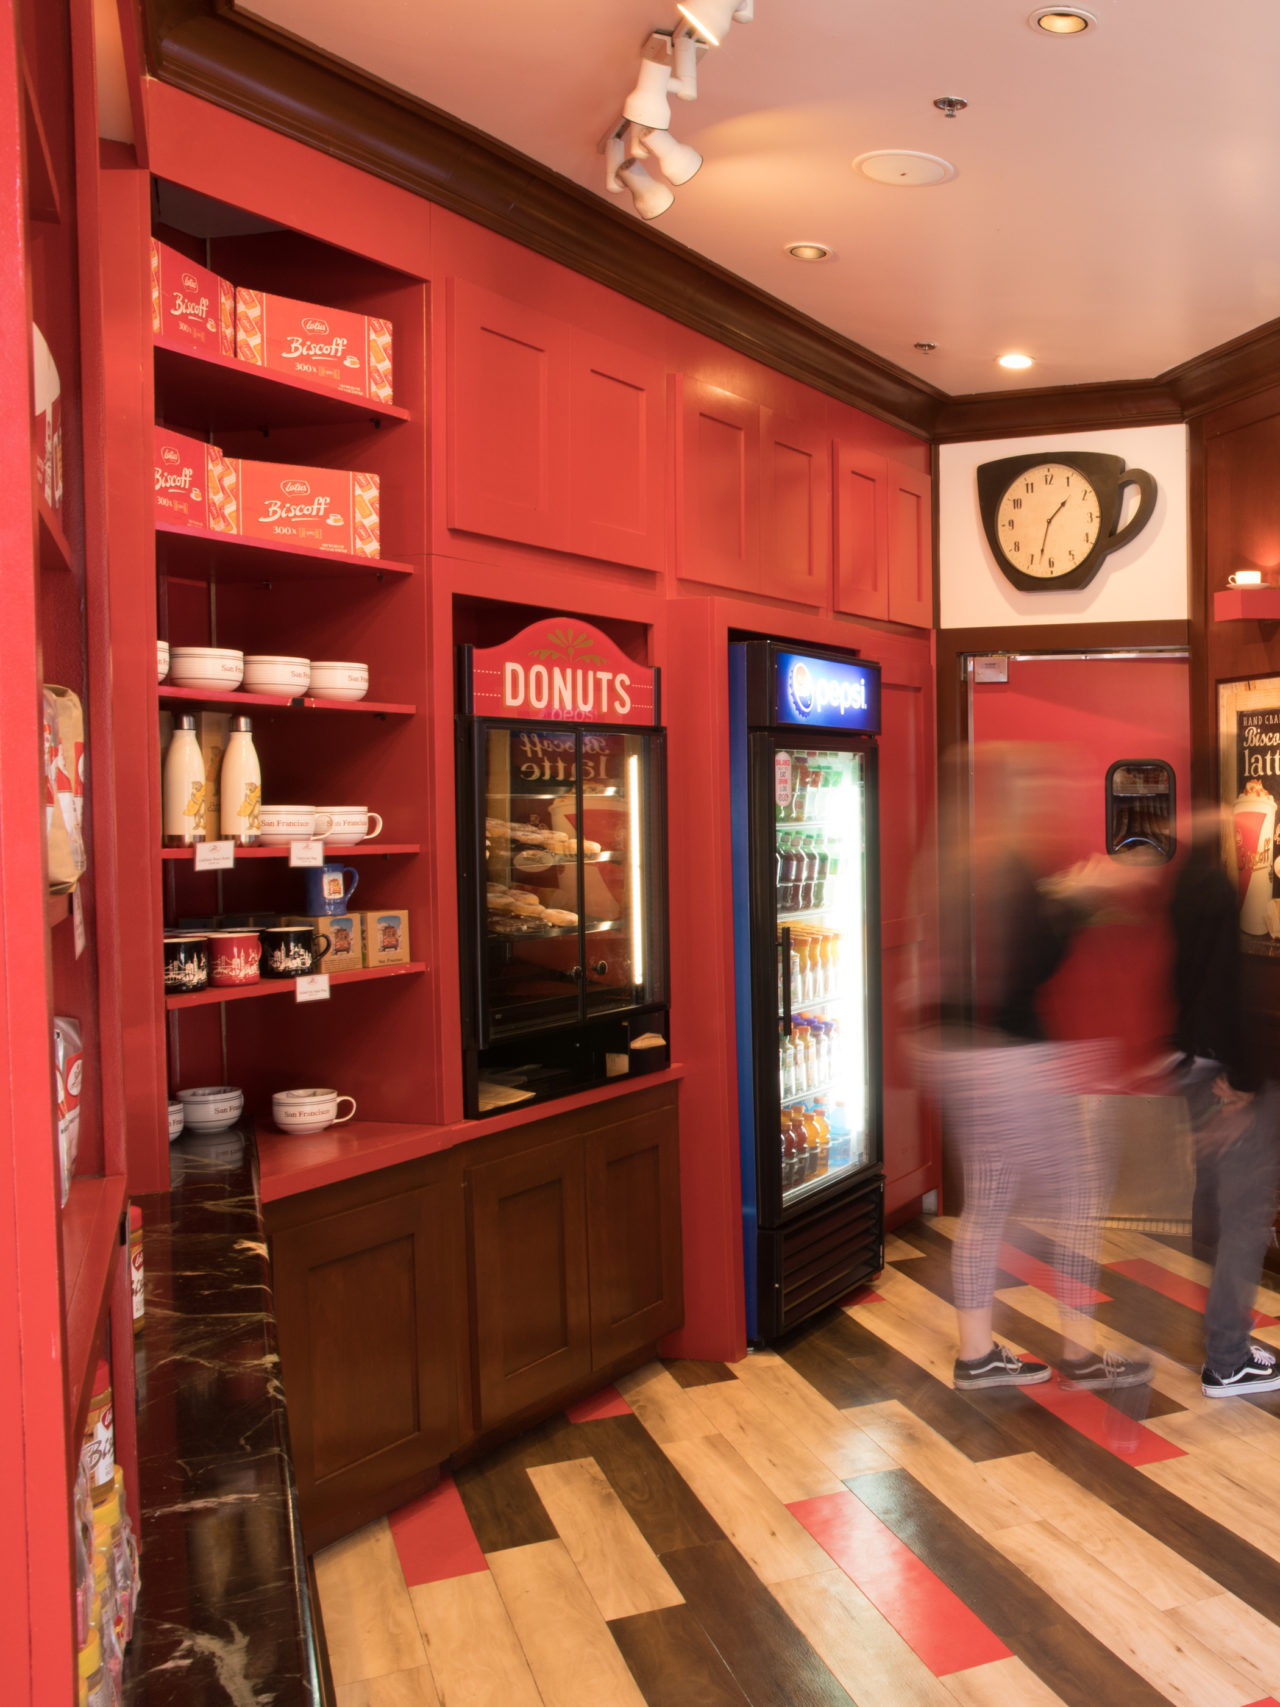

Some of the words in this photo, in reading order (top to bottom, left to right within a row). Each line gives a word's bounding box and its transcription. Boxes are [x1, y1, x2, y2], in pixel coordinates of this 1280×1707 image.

[170, 292, 209, 318] Biscoff
[281, 337, 347, 358] Biscoff
[154, 467, 193, 490] Biscoff
[286, 482, 307, 492] Lotus
[258, 497, 330, 522] Biscoff
[505, 662, 631, 714] DONUTS
[816, 678, 865, 715] pepsi
[1243, 717, 1262, 726] HAND
